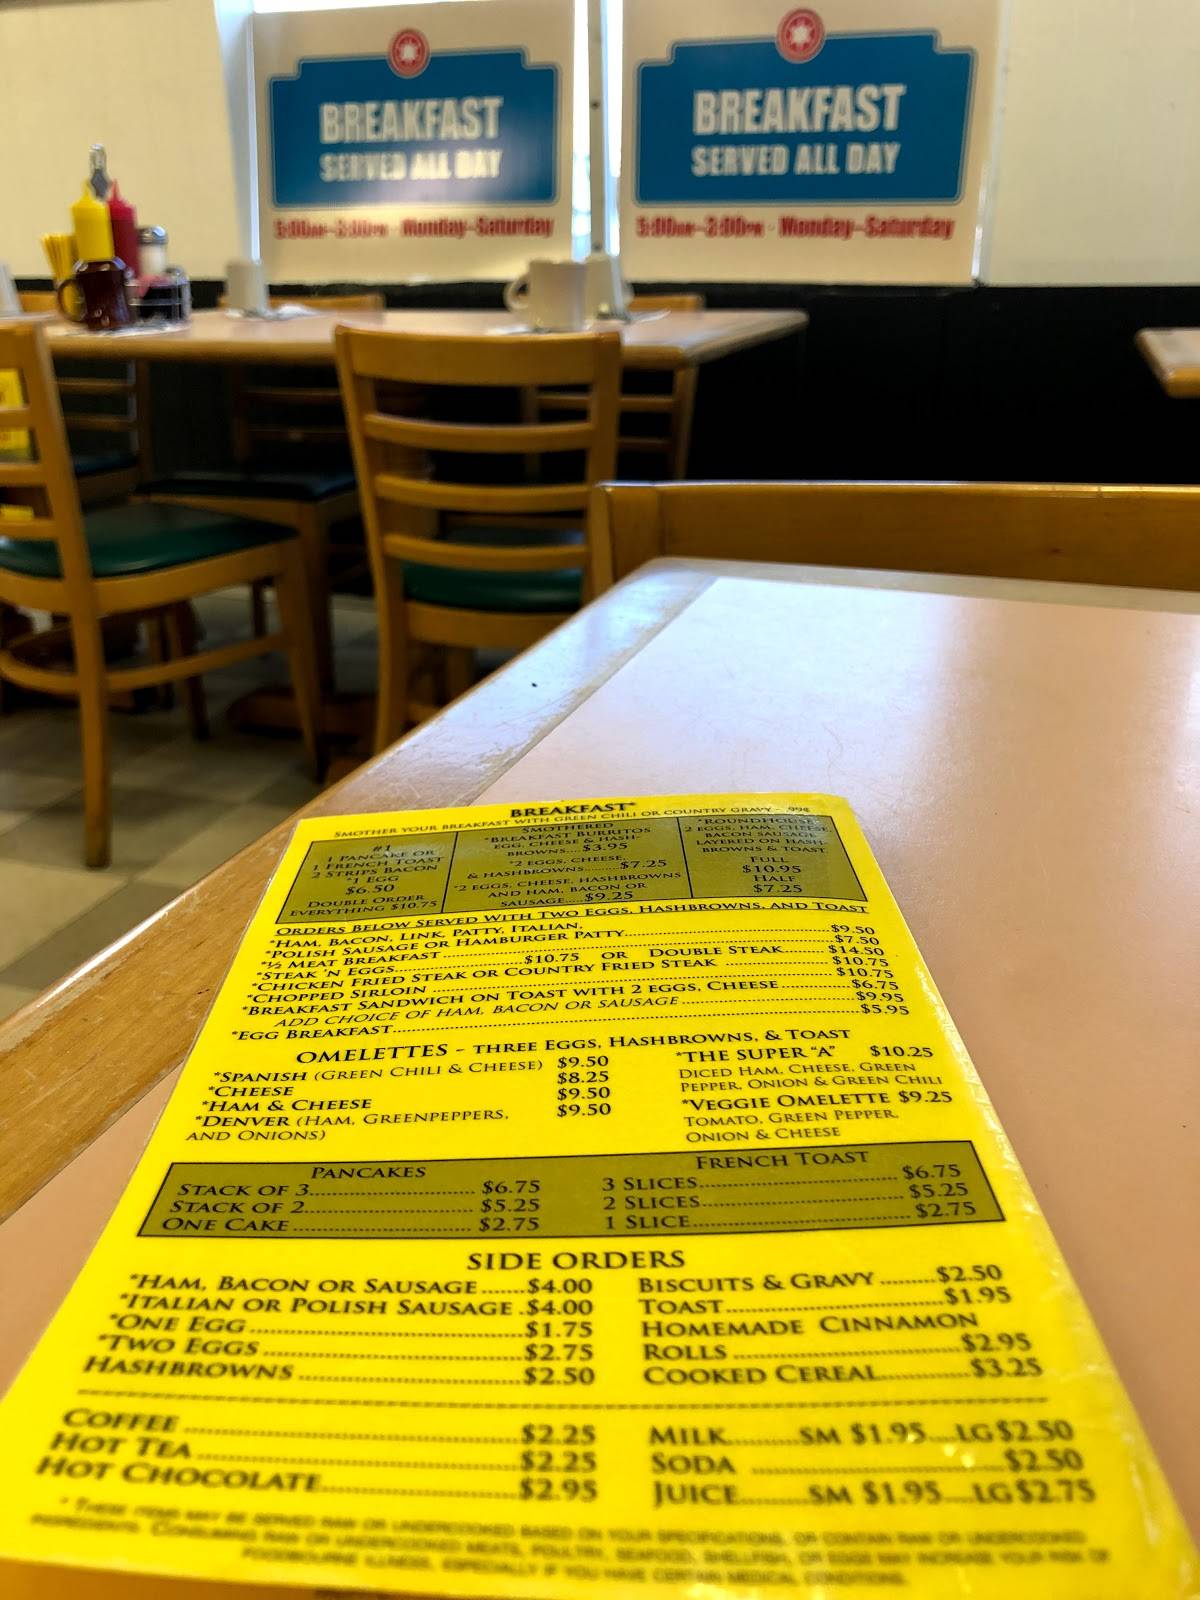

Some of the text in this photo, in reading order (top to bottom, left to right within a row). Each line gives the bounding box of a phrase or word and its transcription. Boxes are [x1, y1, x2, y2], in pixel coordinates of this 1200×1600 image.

[693, 84, 906, 135] BREAKFAST
[319, 97, 504, 144] BREAKFAST
[319, 149, 504, 181] SERVED ALL DAY
[691, 142, 901, 177] SERVED ALL DAY
[442, 820, 510, 829] BREAKFAST
[554, 814, 596, 822] GREEN
[582, 842, 628, 852] $3.95
[311, 865, 438, 879] 2 STRIPS BACON
[482, 866, 584, 877] HASHBROWNS
[620, 859, 666, 869] $7.25
[742, 864, 802, 873] $10.95
[754, 874, 796, 882] HALF
[345, 884, 394, 895] $6.50
[488, 890, 520, 898] AND
[570, 884, 626, 892] BACON
[584, 891, 633, 901] $9.25
[752, 884, 802, 893] $7.25
[290, 900, 437, 916] EVERYTHING $10.75
[308, 895, 424, 908] DOUBLE ORDER
[275, 902, 868, 936] ORDERS BELOW SERVED WITH TWO EGGS, HASHBROWNS, AND TOAST
[342, 943, 418, 955] SAUSAGE
[424, 940, 448, 948] OR
[456, 933, 567, 946] HAMBURGER
[574, 930, 624, 939] PATTY
[830, 924, 874, 934] $9.50
[400, 931, 444, 940] LINK,
[452, 927, 504, 936] PATTY,
[510, 922, 583, 932] ITALIAN,
[347, 965, 394, 976] EGGS
[524, 952, 578, 964] $10.75
[600, 951, 628, 959] OR
[650, 947, 722, 957] DOUBLE
[728, 945, 782, 954] STEAK
[828, 945, 884, 955] $14.50
[350, 986, 426, 998] SIRLOIN
[836, 967, 894, 978] $10.75
[286, 1025, 392, 1039] BREAKFAST
[860, 1003, 909, 1015] $5.95
[296, 1029, 850, 1063] OMELETTES THREE EGGS, HASHBROWNS, & TOAST
[736, 1047, 808, 1060] SUPER
[868, 1045, 933, 1057] $10.25
[314, 1069, 382, 1080] (GREEN
[390, 1066, 442, 1076] CHILI
[448, 1063, 462, 1073] &
[468, 1060, 542, 1072] CHEESE)
[556, 1055, 608, 1068] $9.50
[680, 1074, 943, 1092] PEPPER, ONION & GREEN CHILI
[266, 1100, 284, 1111] &
[290, 1099, 372, 1110] CHEESE
[556, 1087, 610, 1100] $9.50
[777, 1093, 890, 1106] OMELETTE
[898, 1090, 952, 1103] $9.25
[696, 1151, 870, 1169] FRENCH TOAST
[310, 1167, 426, 1178] PANCAKES
[600, 1164, 961, 1191] 3 SLICES $6.75
[177, 1184, 251, 1196] STACK
[257, 1185, 288, 1196] OF
[481, 1180, 540, 1194] $6.75
[160, 1217, 540, 1231] ONE CAKE $2.75
[466, 1250, 686, 1270] SIDE ORDERS
[216, 1276, 310, 1291] BACON
[318, 1279, 356, 1292] OR
[364, 1279, 477, 1294] SAUSAGE
[526, 1278, 592, 1294] $4.00
[638, 1264, 1003, 1293] BISCUITS & GRAVY $2.50
[188, 1316, 246, 1333] EGG
[526, 1321, 593, 1338] $1.75
[640, 1313, 978, 1337] HOMEMADE CINNAMON
[642, 1333, 1032, 1360] ROLLS $2.95
[84, 1357, 594, 1385] HASHBROWNS $2.50
[62, 1409, 596, 1445] COFFEE $2.25
[649, 1427, 727, 1445] MILK
[798, 1427, 842, 1445] SM
[850, 1422, 926, 1444] $1.95
[996, 1420, 1074, 1442] $2.50
[35, 1457, 598, 1500] HOT CHOCOLATE $2.95
